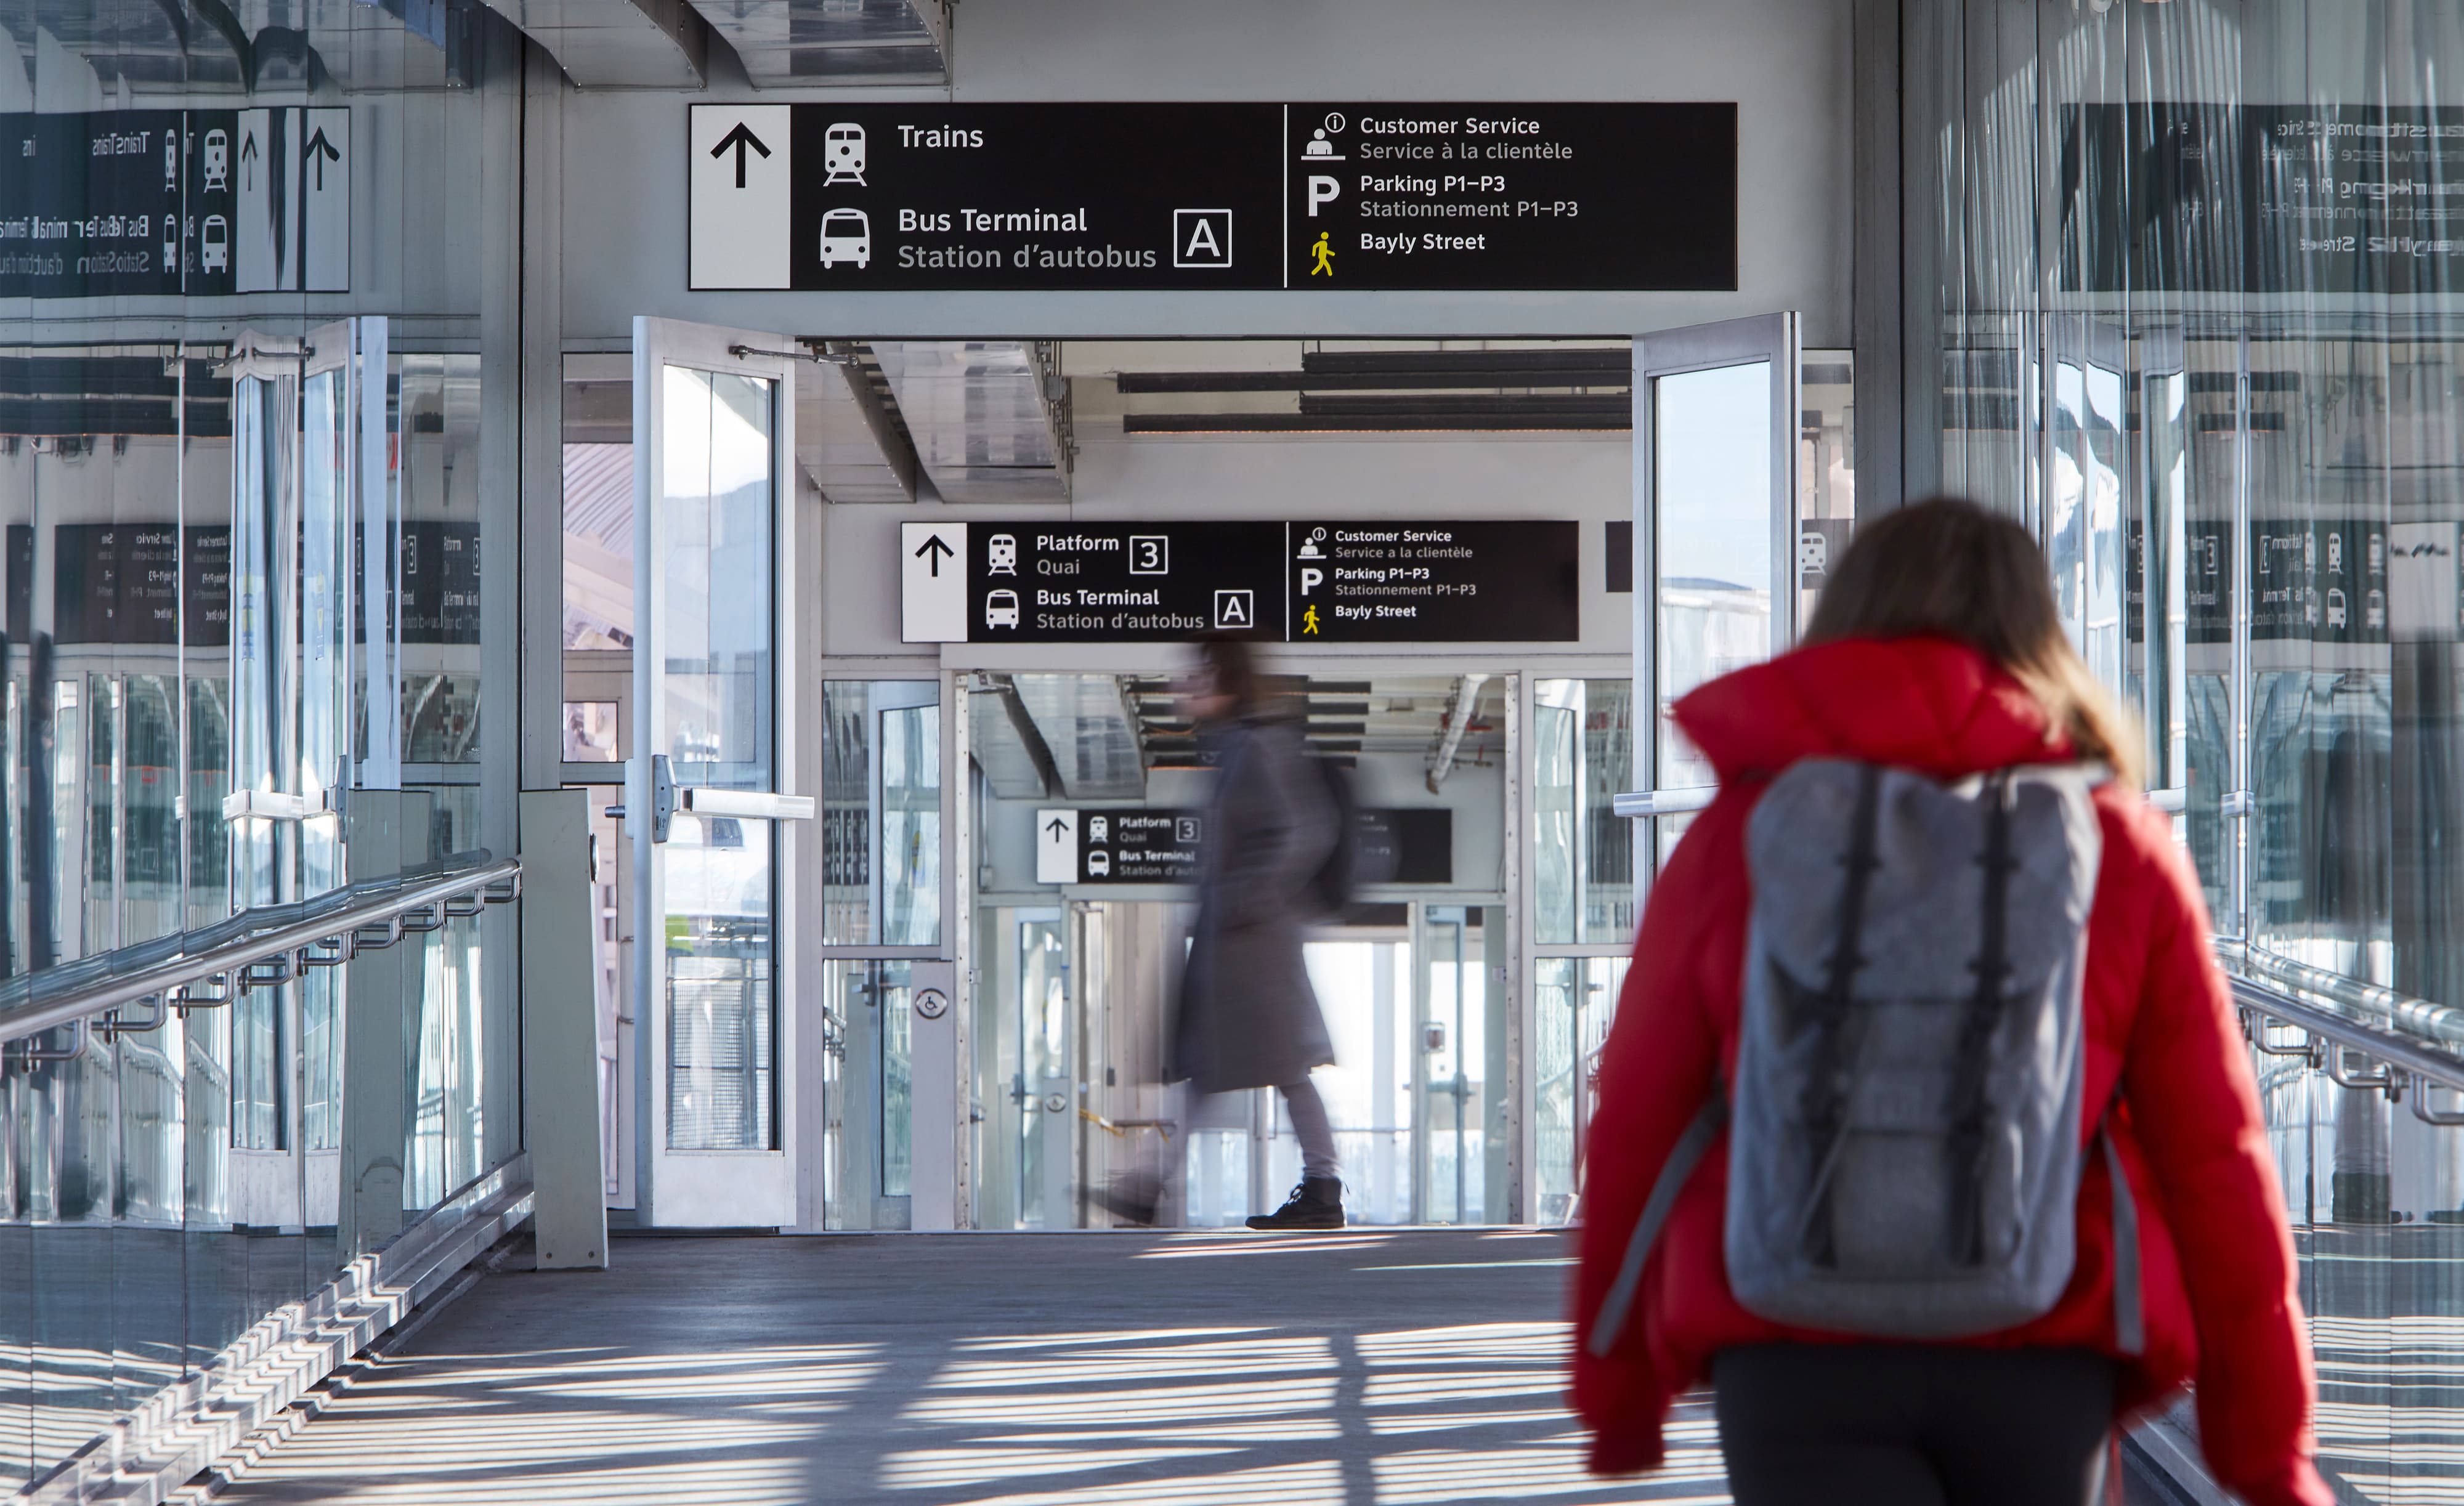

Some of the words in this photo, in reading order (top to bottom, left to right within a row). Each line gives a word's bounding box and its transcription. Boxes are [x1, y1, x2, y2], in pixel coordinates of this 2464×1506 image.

[1360, 117, 1459, 134] Customer
[1465, 117, 1540, 134] Service
[898, 124, 984, 148] Trains
[1360, 142, 1434, 160] Service
[1441, 142, 1453, 160] à
[1461, 142, 1478, 160] la
[1486, 142, 1573, 160] clientèle
[1361, 174, 1437, 196] Parking
[1308, 175, 1340, 217] P
[1360, 200, 1510, 217] Stationnement
[899, 208, 951, 232] Bus
[960, 207, 1087, 232] Terminal
[1186, 219, 1221, 257] A
[1361, 232, 1417, 254] Bayly
[1422, 233, 1485, 250] Street
[898, 245, 1001, 268] Station
[1013, 244, 1156, 268] d'autobus
[1037, 534, 1119, 551] Platform
[1335, 530, 1400, 542] Customer
[1403, 530, 1453, 542] Service
[1140, 542, 1158, 568] 3
[1335, 546, 1384, 558] Service
[1400, 546, 1412, 558] la
[1416, 546, 1473, 559] clientèle
[1037, 559, 1080, 576] Quai
[1335, 567, 1385, 583] Parking
[1301, 567, 1324, 596] P
[1335, 584, 1432, 596] Stationnement
[1037, 589, 1072, 605] Bus
[1076, 588, 1160, 605] Terminal
[1223, 596, 1246, 622] A
[1335, 604, 1372, 620] Bayly
[1375, 605, 1417, 618] Street
[1037, 613, 1104, 629] Station
[1111, 612, 1204, 629] d'autobus
[1119, 816, 1172, 828] Platform
[1183, 822, 1195, 838] 3
[1119, 832, 1147, 843] Quai
[1119, 849, 1142, 862] Bus
[1145, 849, 1196, 862] Terminal
[1119, 865, 1162, 876] Station
